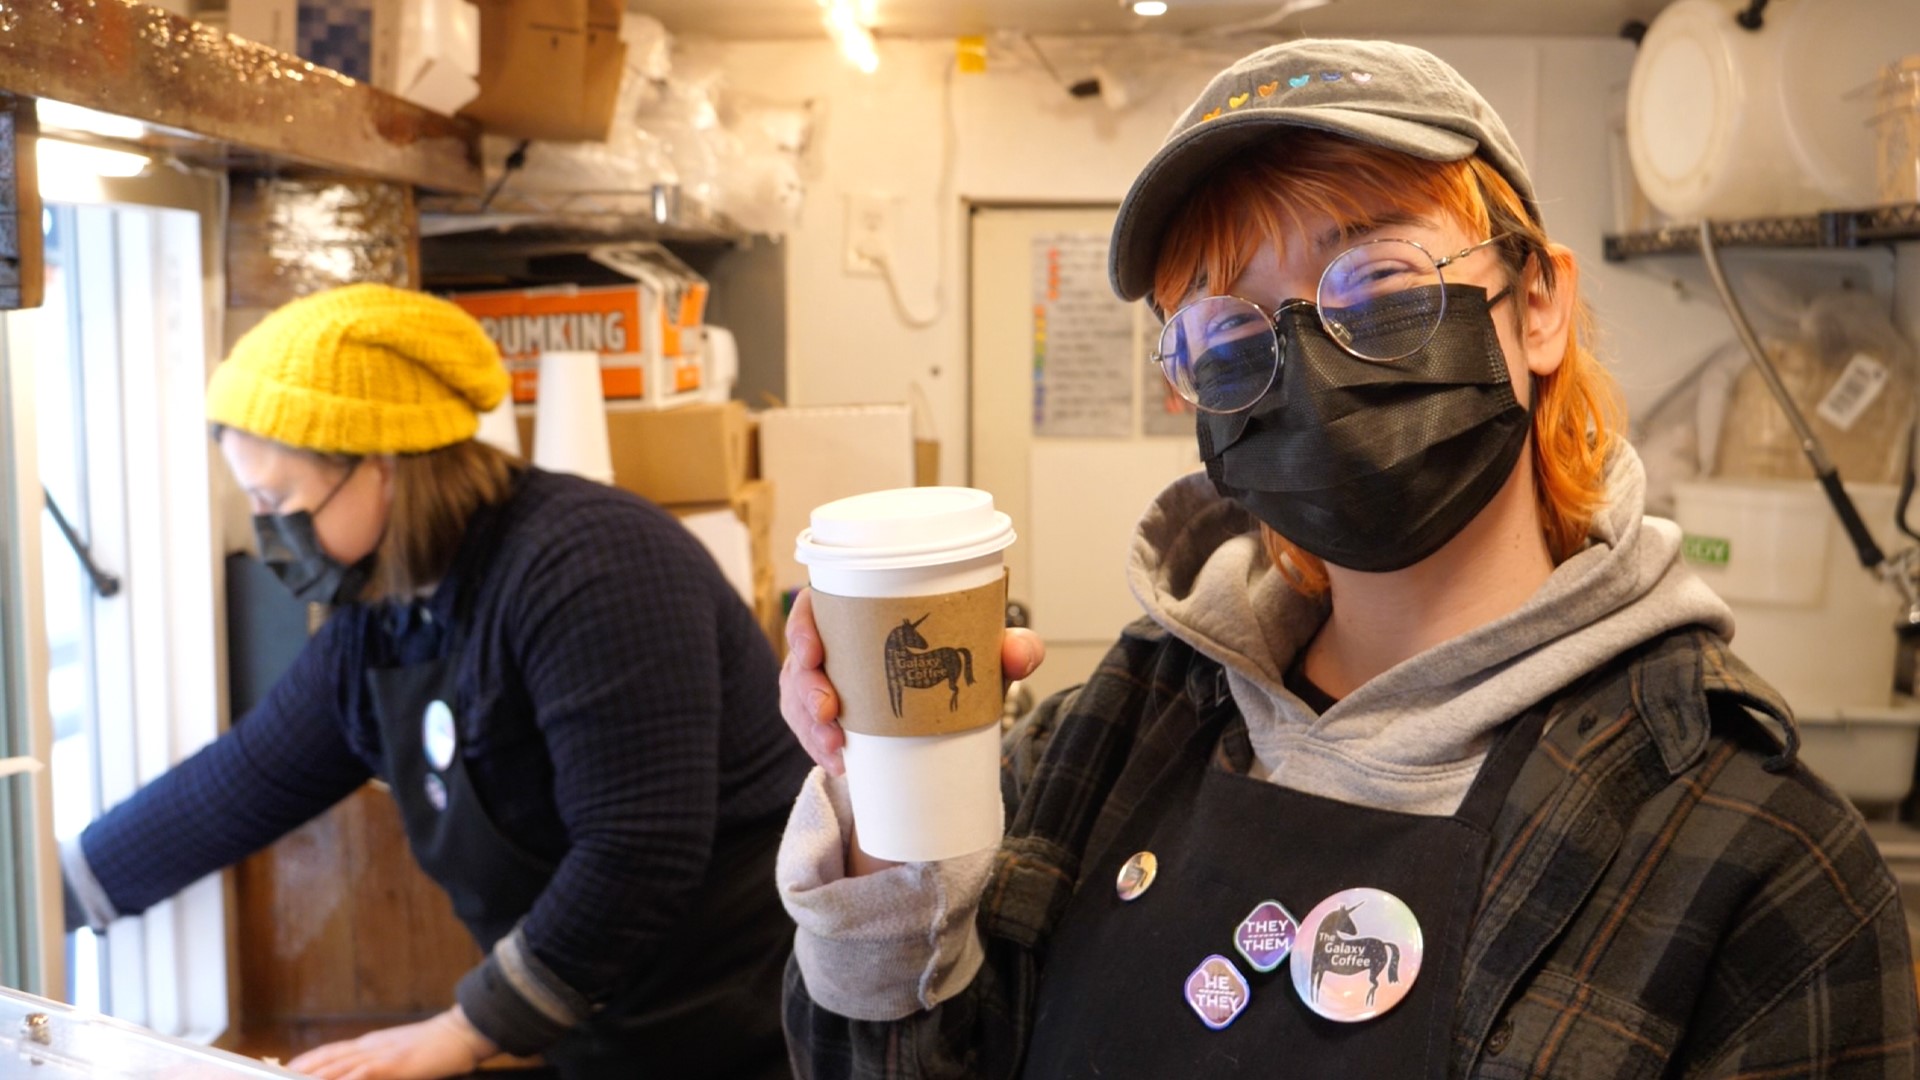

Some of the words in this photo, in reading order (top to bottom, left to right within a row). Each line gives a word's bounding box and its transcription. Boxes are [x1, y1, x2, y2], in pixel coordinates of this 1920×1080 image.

[480, 311, 626, 356] PUMKING
[899, 656, 939, 669] Galaxy
[907, 667, 947, 679] Coffee
[1246, 919, 1289, 933] THEY
[1320, 932, 1336, 942] The
[1243, 937, 1289, 952] THEM
[1324, 942, 1366, 957] Galaxy
[1331, 954, 1371, 967] Coffee
[1203, 973, 1230, 990] HE
[1195, 993, 1239, 1011] THEY
